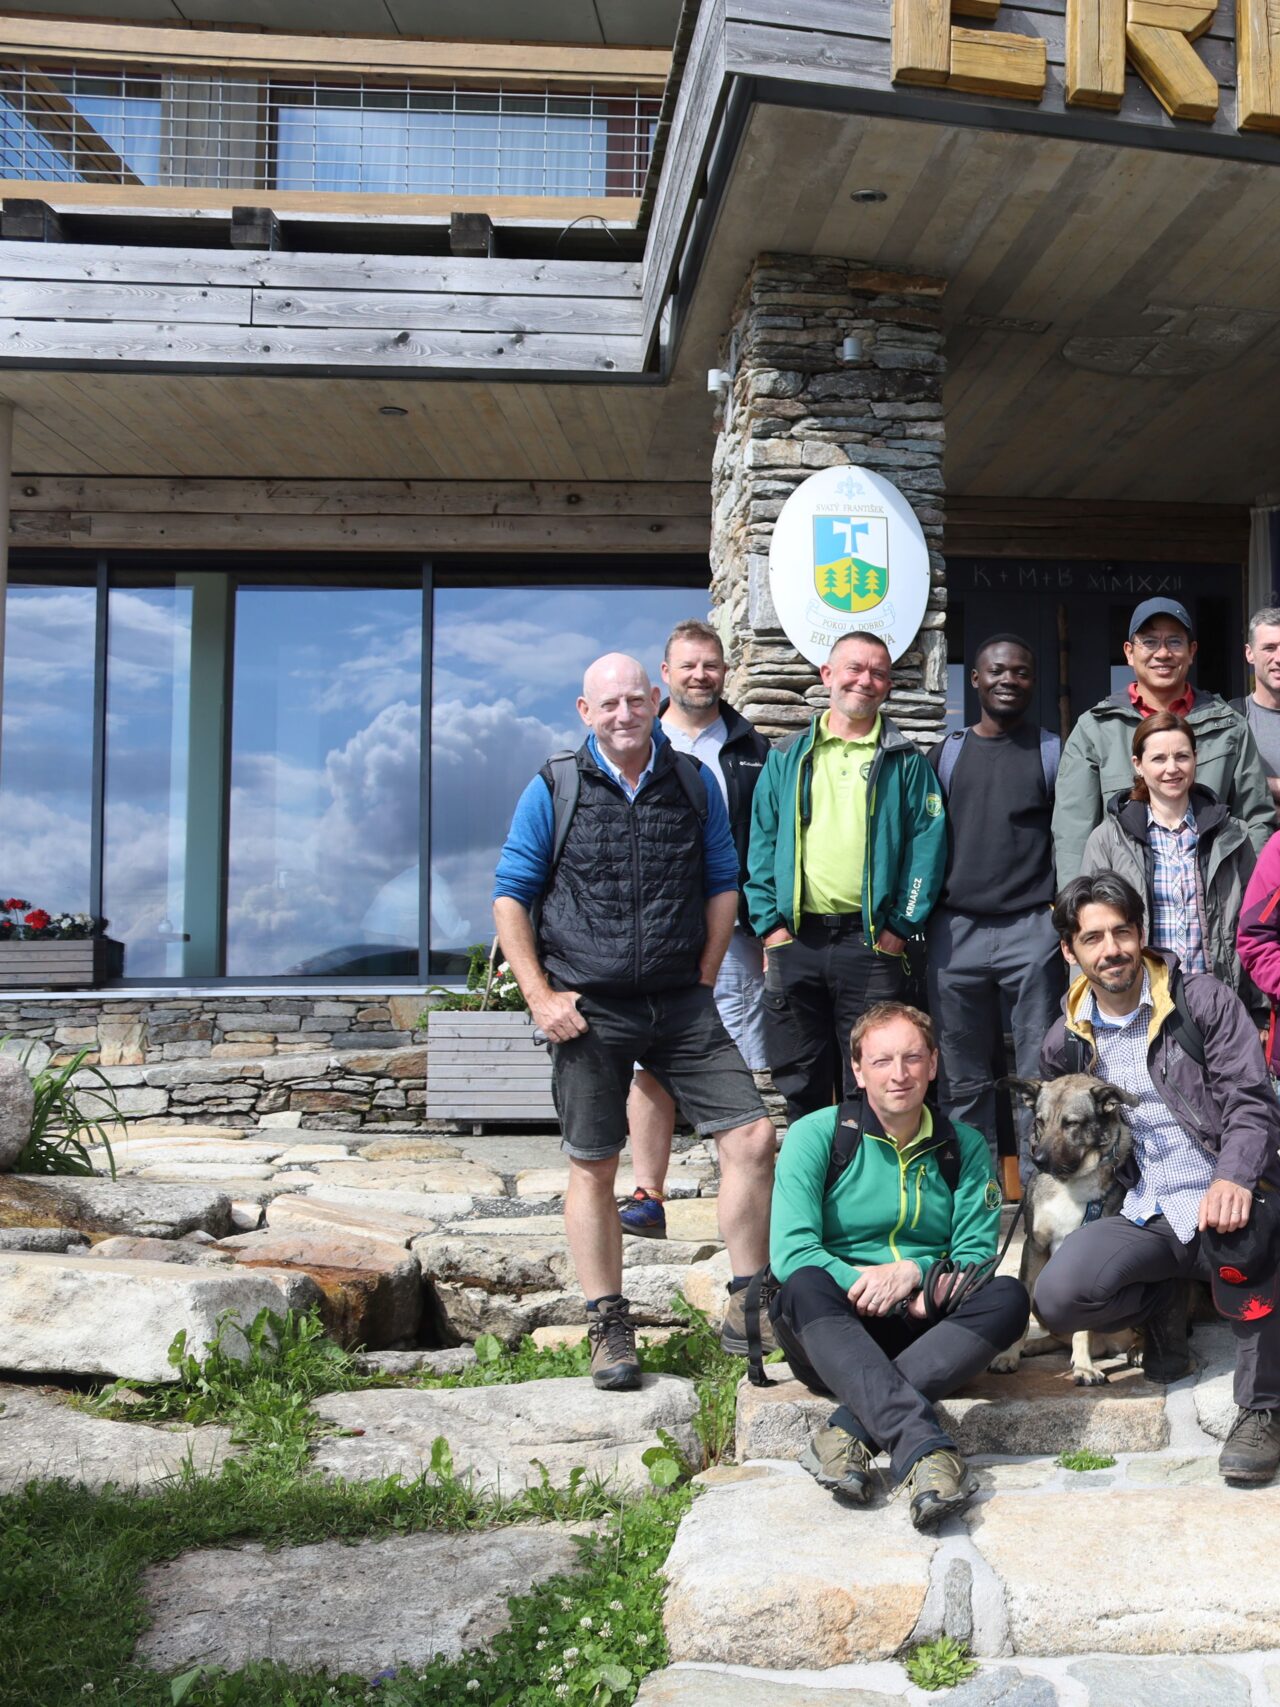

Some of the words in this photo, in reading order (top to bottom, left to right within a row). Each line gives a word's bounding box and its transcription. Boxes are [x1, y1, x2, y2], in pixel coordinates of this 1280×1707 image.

[815, 502, 840, 512] SVATÝ
[822, 619, 847, 630] POKOJ
[858, 619, 885, 631] DOBRO
[905, 877, 923, 917] KRNAP.CZ
